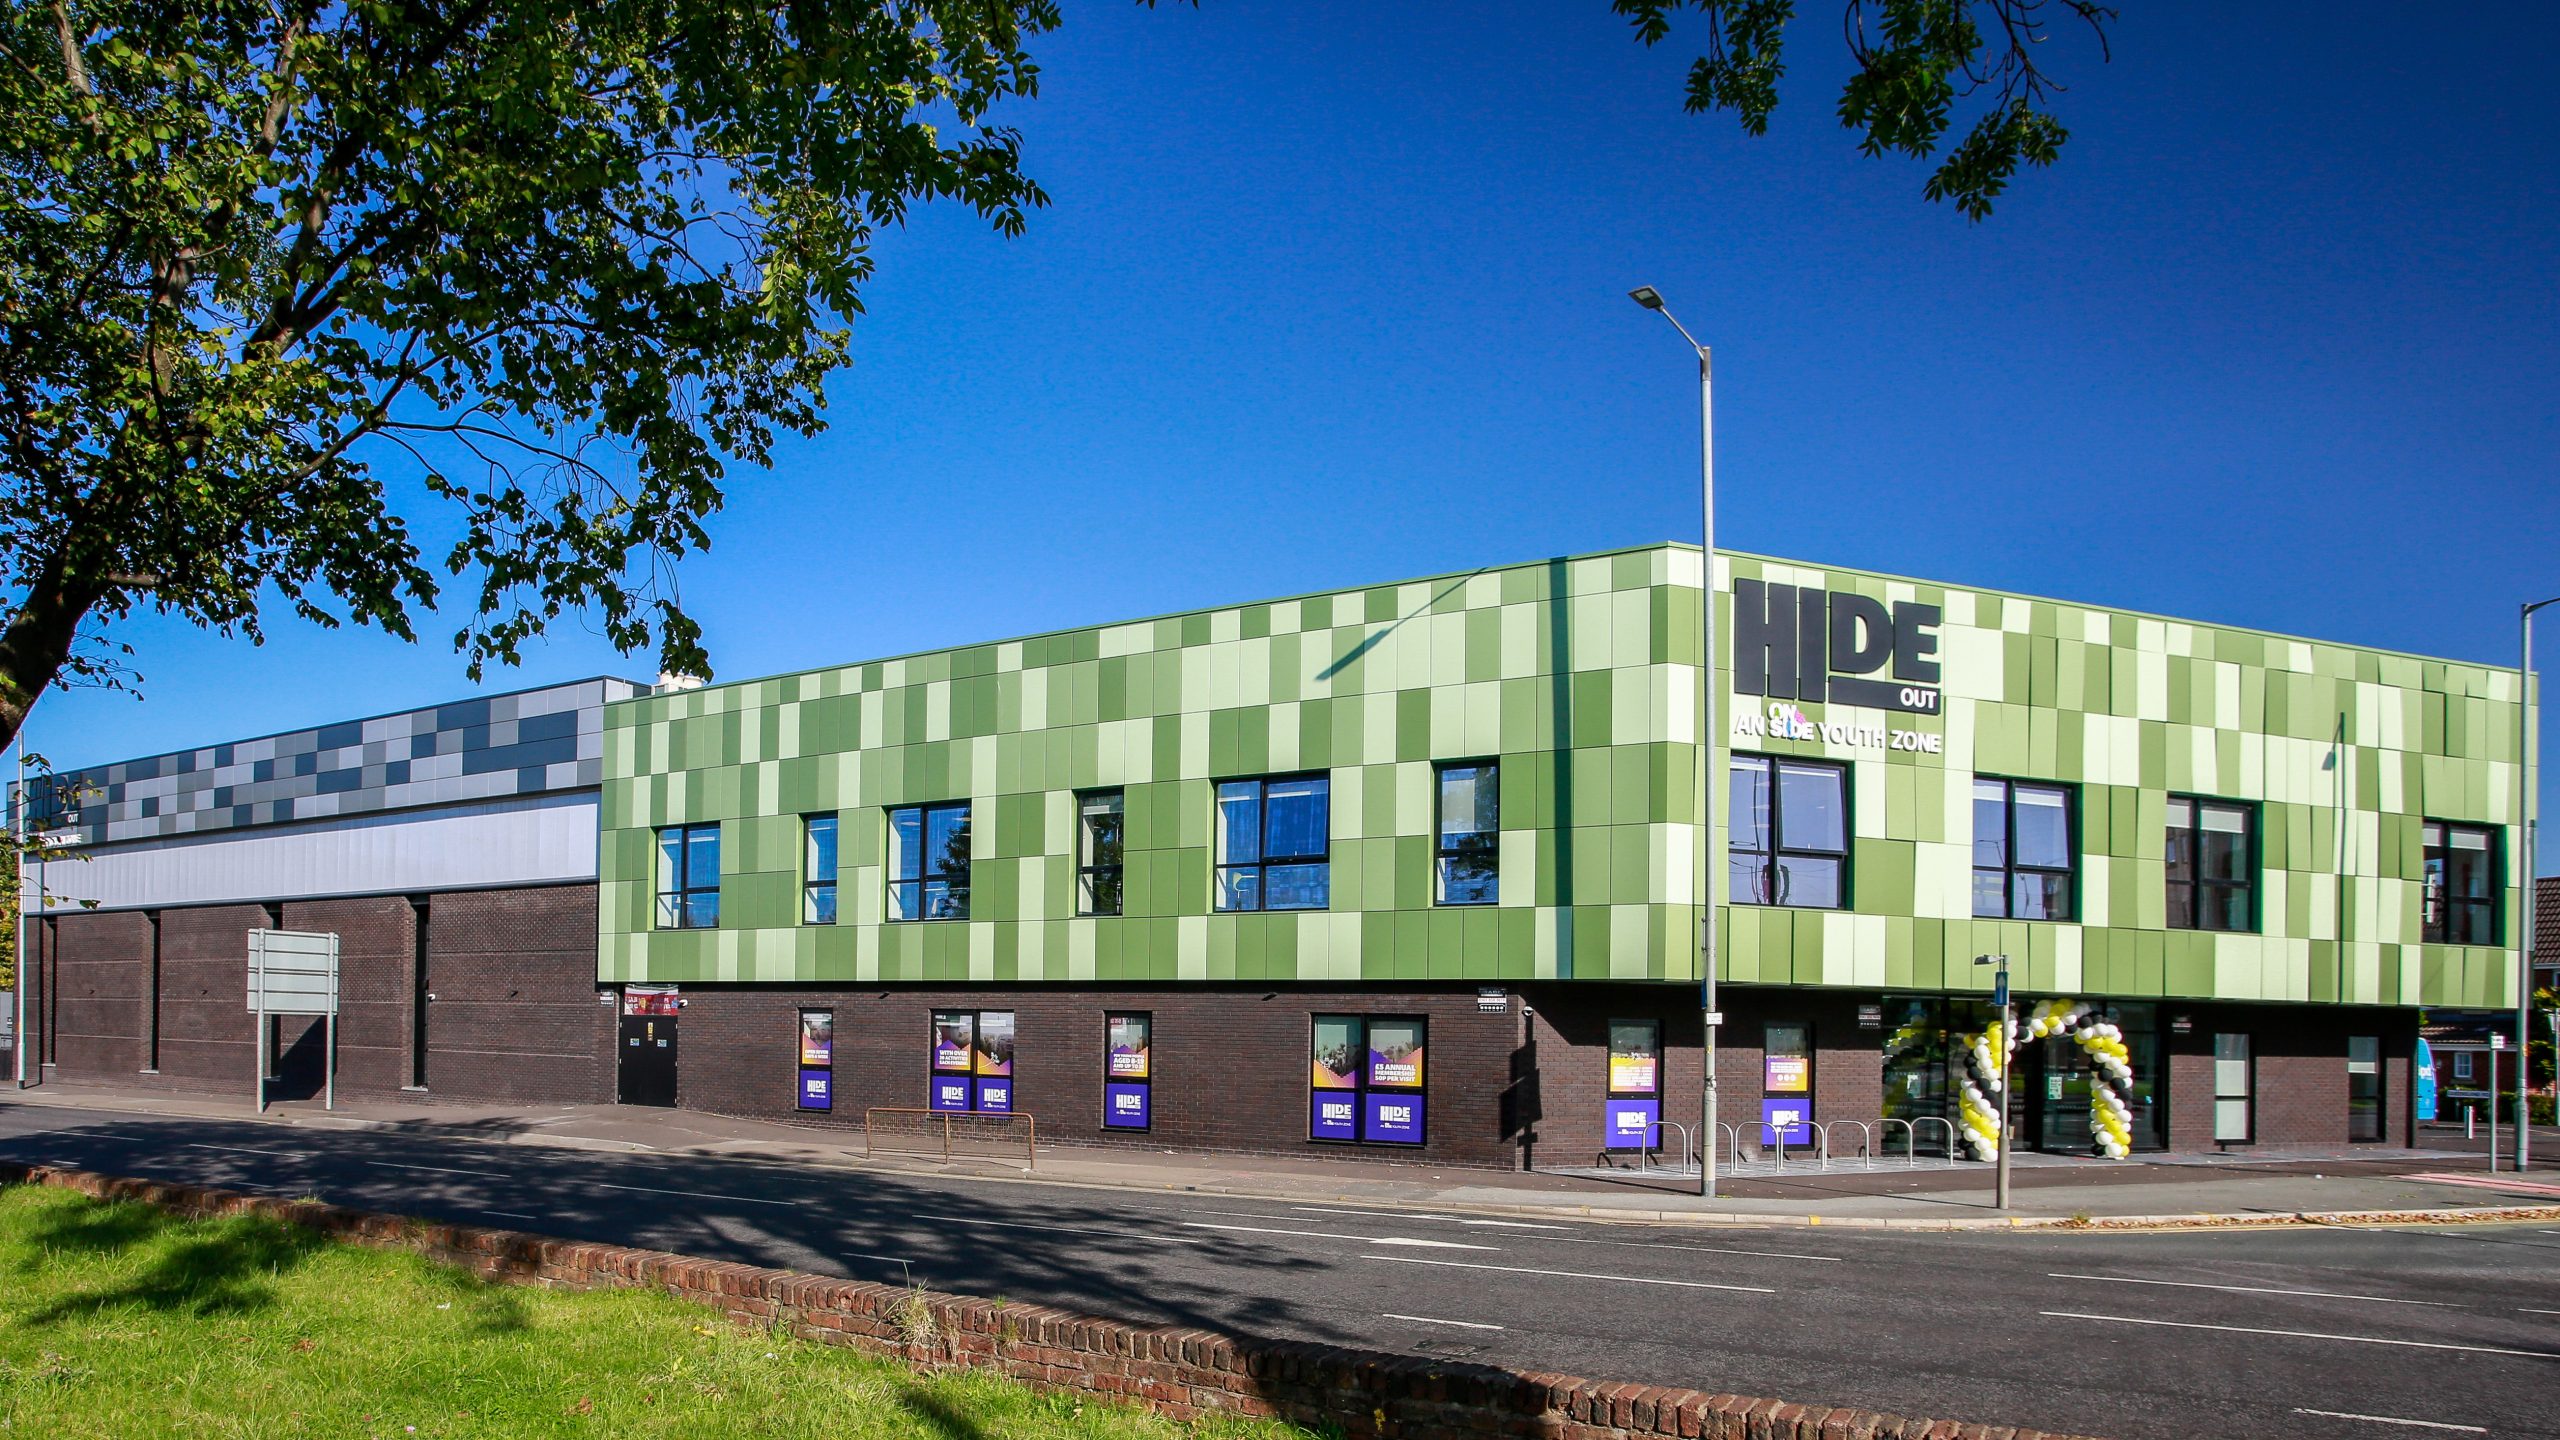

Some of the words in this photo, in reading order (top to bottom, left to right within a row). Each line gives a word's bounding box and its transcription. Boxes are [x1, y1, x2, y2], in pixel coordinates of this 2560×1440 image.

[1735, 578, 1941, 703] HIDE
[1900, 687, 1937, 709] OUT
[1768, 703, 1797, 719] ON
[1735, 714, 1765, 736] AN
[1768, 719, 1815, 740] SIDE
[1816, 721, 1884, 748] YOUTH
[1890, 730, 1942, 754] ZONE
[67, 814, 79, 823] OUT
[807, 1080, 826, 1093] HIDE
[942, 1086, 963, 1100] HIDE
[984, 1088, 1006, 1102] HIDE
[1116, 1095, 1141, 1108] HIDE
[1322, 1103, 1351, 1118] HIDE
[1380, 1106, 1410, 1121] HIDE
